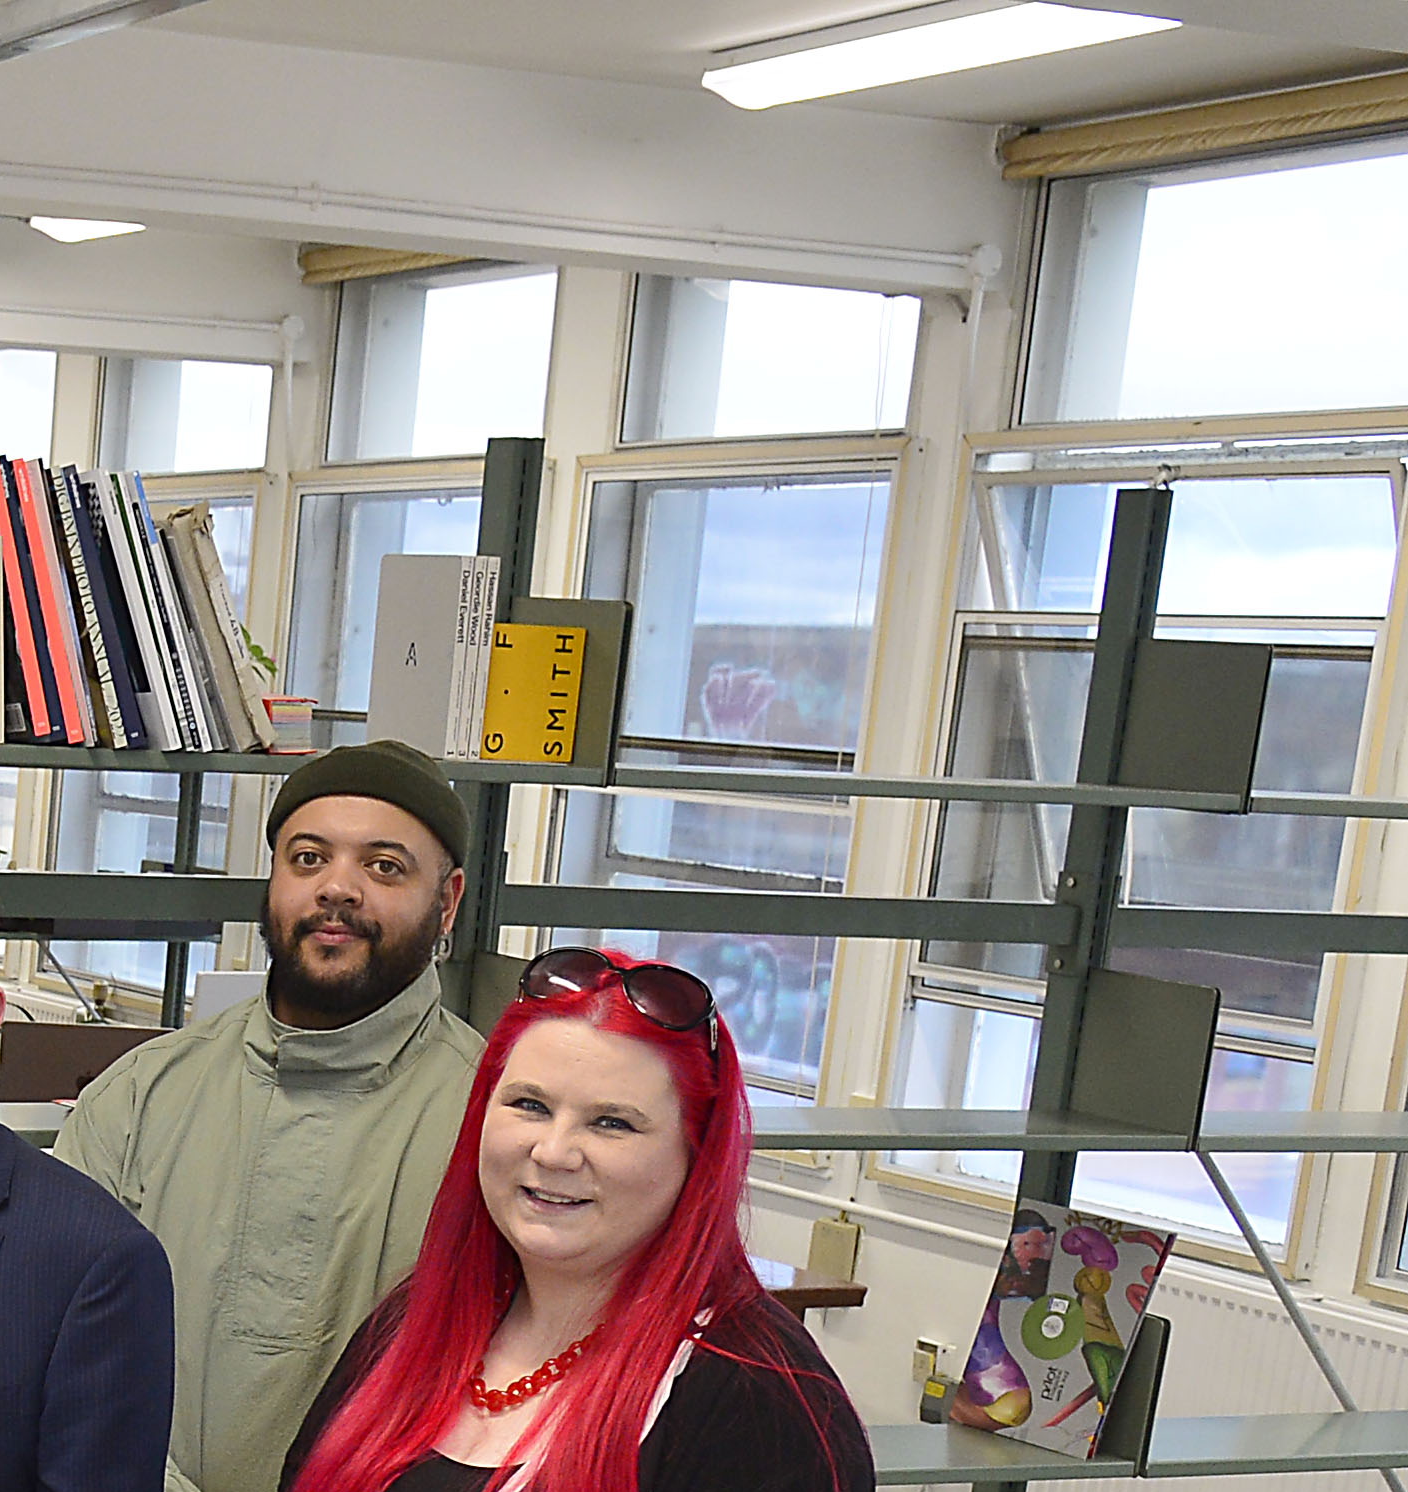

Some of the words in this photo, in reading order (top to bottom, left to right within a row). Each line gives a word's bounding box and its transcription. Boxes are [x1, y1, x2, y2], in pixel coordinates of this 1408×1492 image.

[460, 570, 471, 604] Daniel
[472, 571, 484, 614] Geordie
[486, 571, 497, 611] Hassan
[456, 605, 468, 644] Everett
[469, 615, 480, 647] Wood
[482, 613, 493, 647] Rahim
[543, 634, 575, 756] SMITH
